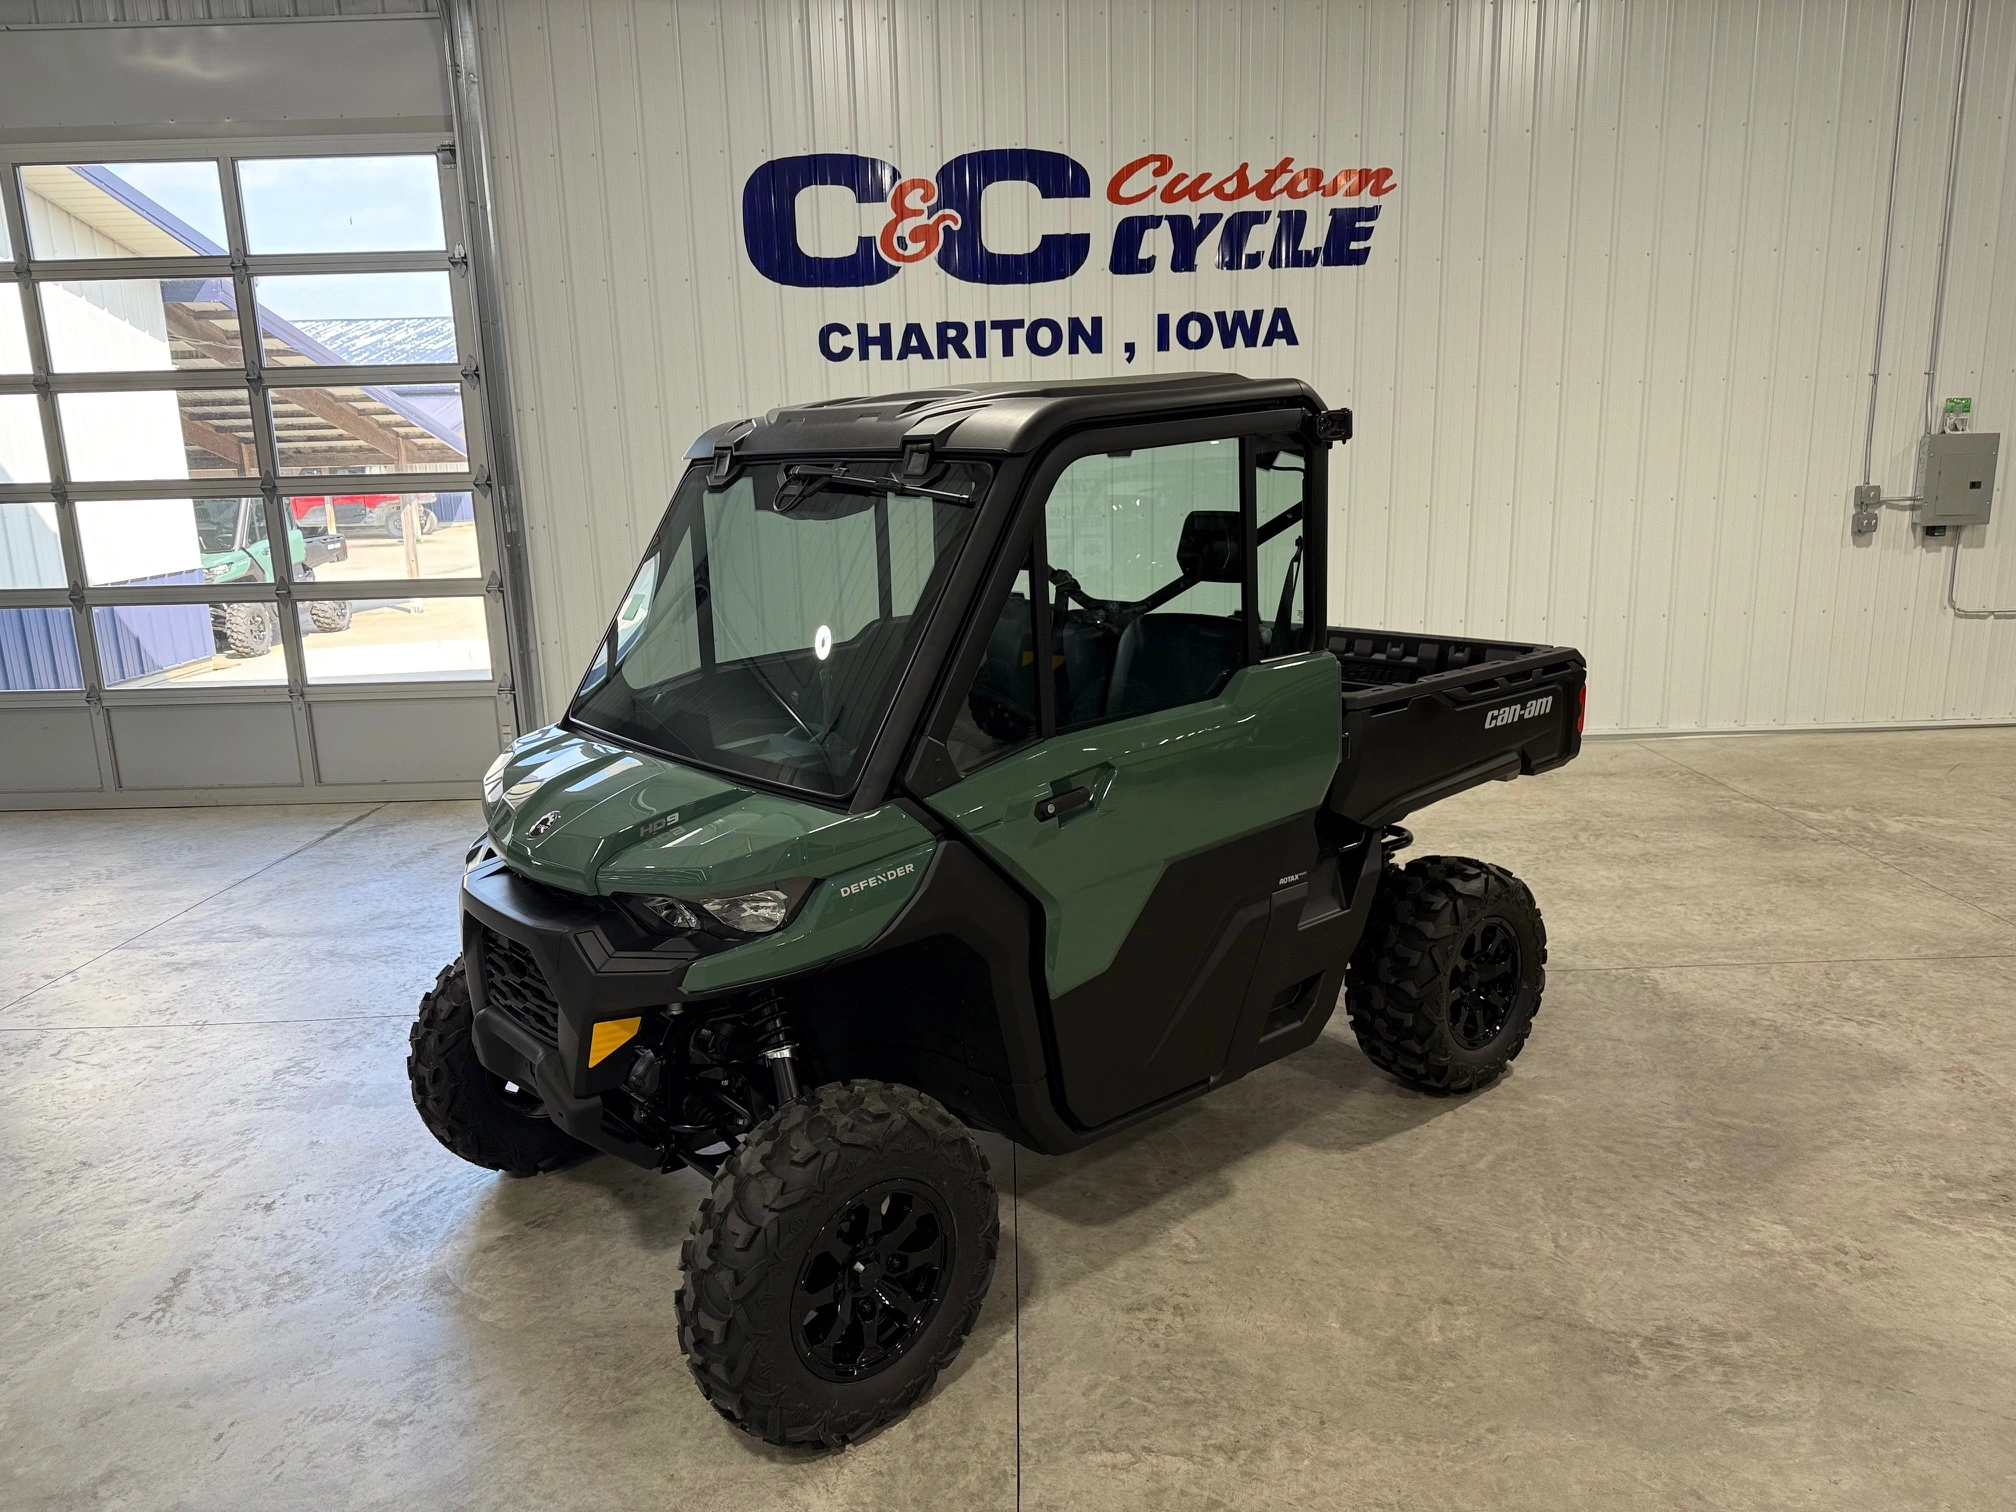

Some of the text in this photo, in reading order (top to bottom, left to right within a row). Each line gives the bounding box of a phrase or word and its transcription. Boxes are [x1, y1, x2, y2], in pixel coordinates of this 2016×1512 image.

[1106, 153, 1396, 205] Custom
[743, 149, 1090, 288] C&C
[1108, 206, 1380, 275] CYCLE
[819, 316, 1102, 361] CHARITON
[1156, 307, 1299, 352] IOWA
[1485, 695, 1553, 729] can-am
[640, 812, 679, 837] HD9
[840, 863, 915, 897] DEFENDER
